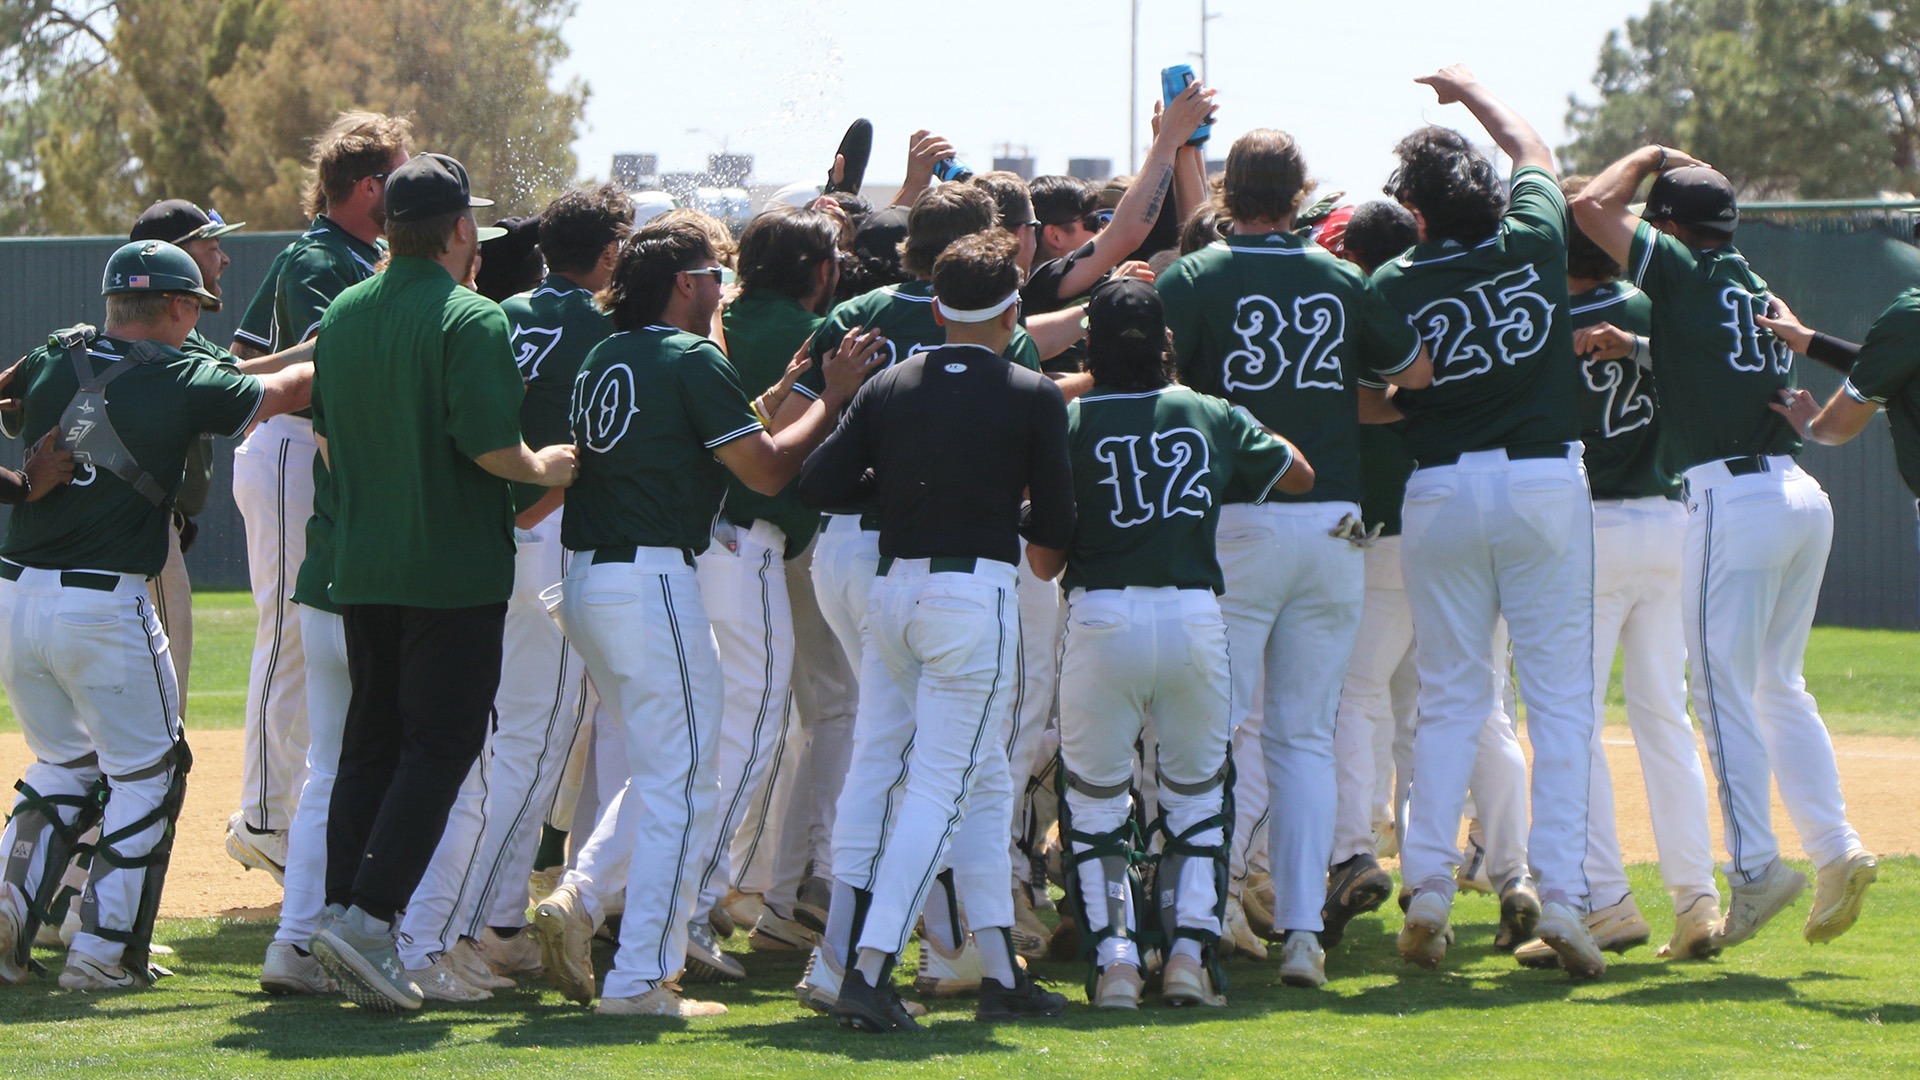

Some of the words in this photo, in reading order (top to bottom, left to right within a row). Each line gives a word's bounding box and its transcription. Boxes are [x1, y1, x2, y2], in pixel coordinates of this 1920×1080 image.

[511, 322, 564, 381] 7
[1223, 292, 1346, 393] 32
[1407, 263, 1556, 387] 25
[569, 363, 641, 454] 10
[1095, 426, 1213, 528] 12
